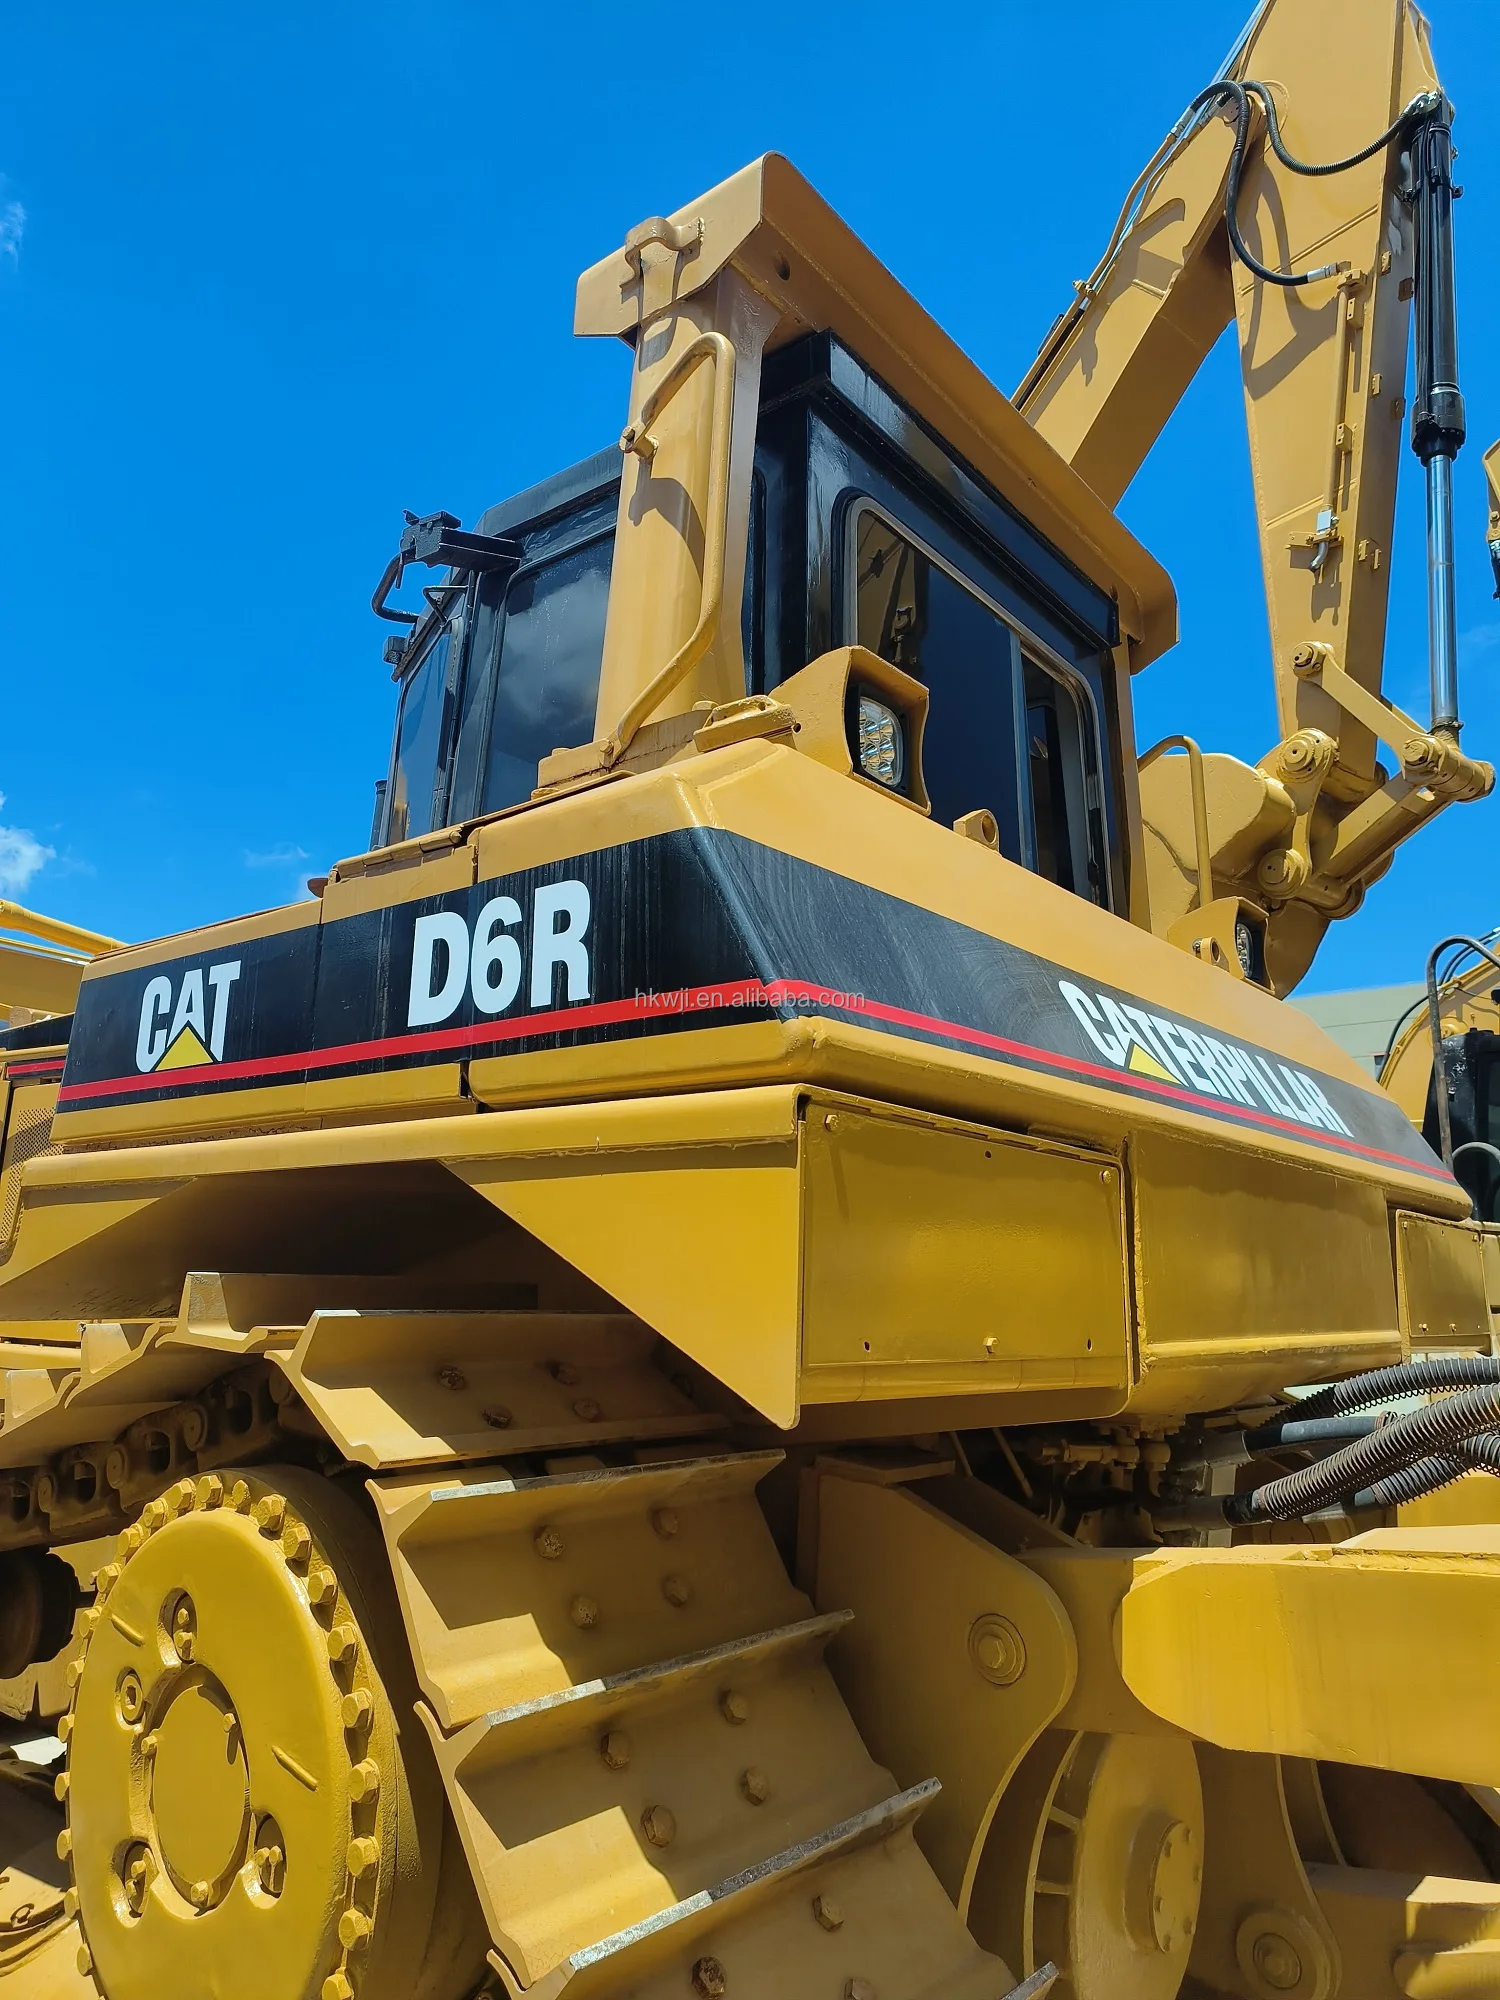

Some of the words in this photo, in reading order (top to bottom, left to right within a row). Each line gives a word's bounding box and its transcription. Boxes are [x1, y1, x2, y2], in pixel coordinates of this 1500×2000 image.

[135, 960, 241, 1073] CAT
[407, 879, 591, 1028] D6R
[1058, 980, 1354, 1138] CATERPILLAR
